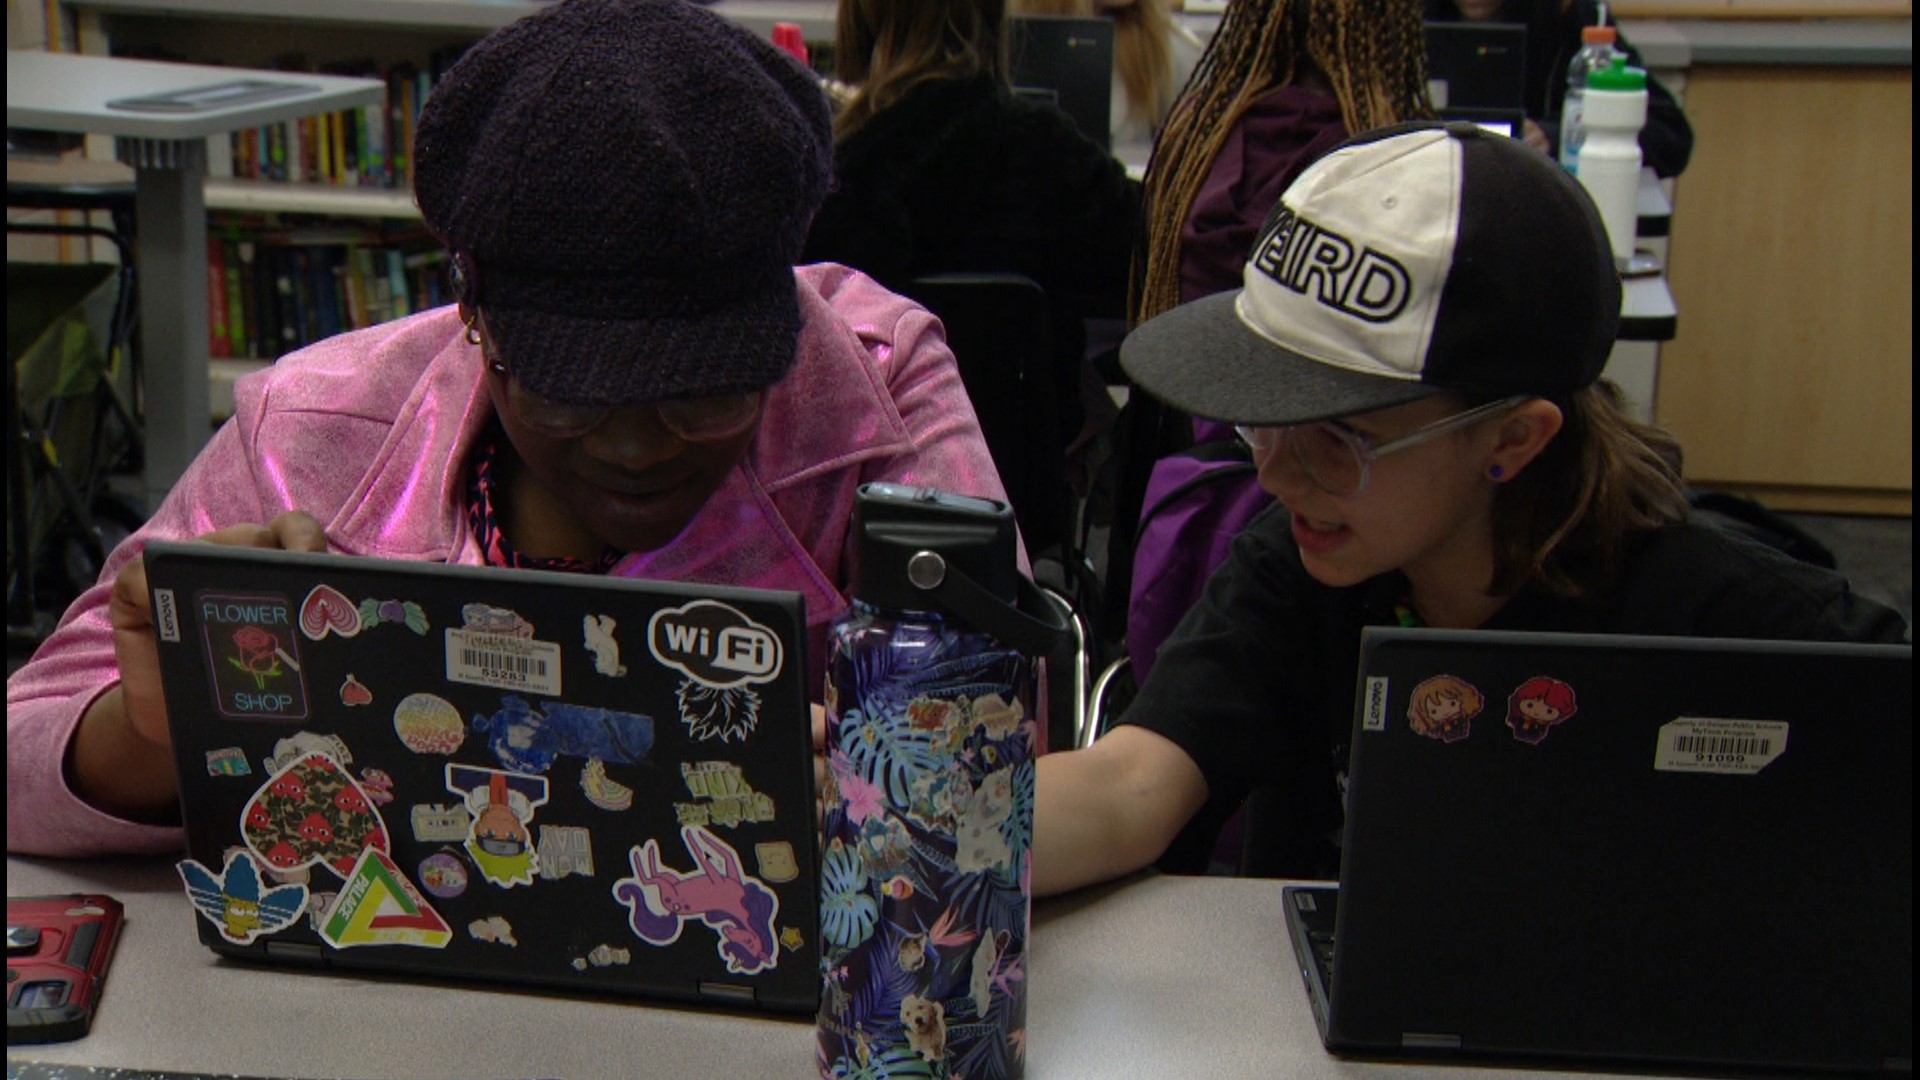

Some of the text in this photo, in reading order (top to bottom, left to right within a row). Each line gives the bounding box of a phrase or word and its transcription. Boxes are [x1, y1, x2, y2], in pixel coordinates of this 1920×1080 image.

[1249, 201, 1412, 324] EIRD
[161, 592, 175, 638] Lenovo
[203, 602, 288, 624] FLOWER
[235, 692, 292, 712] SHOP
[1368, 681, 1383, 726] Lenovo
[1695, 754, 1745, 762] 91099
[337, 872, 370, 921] PALACE
